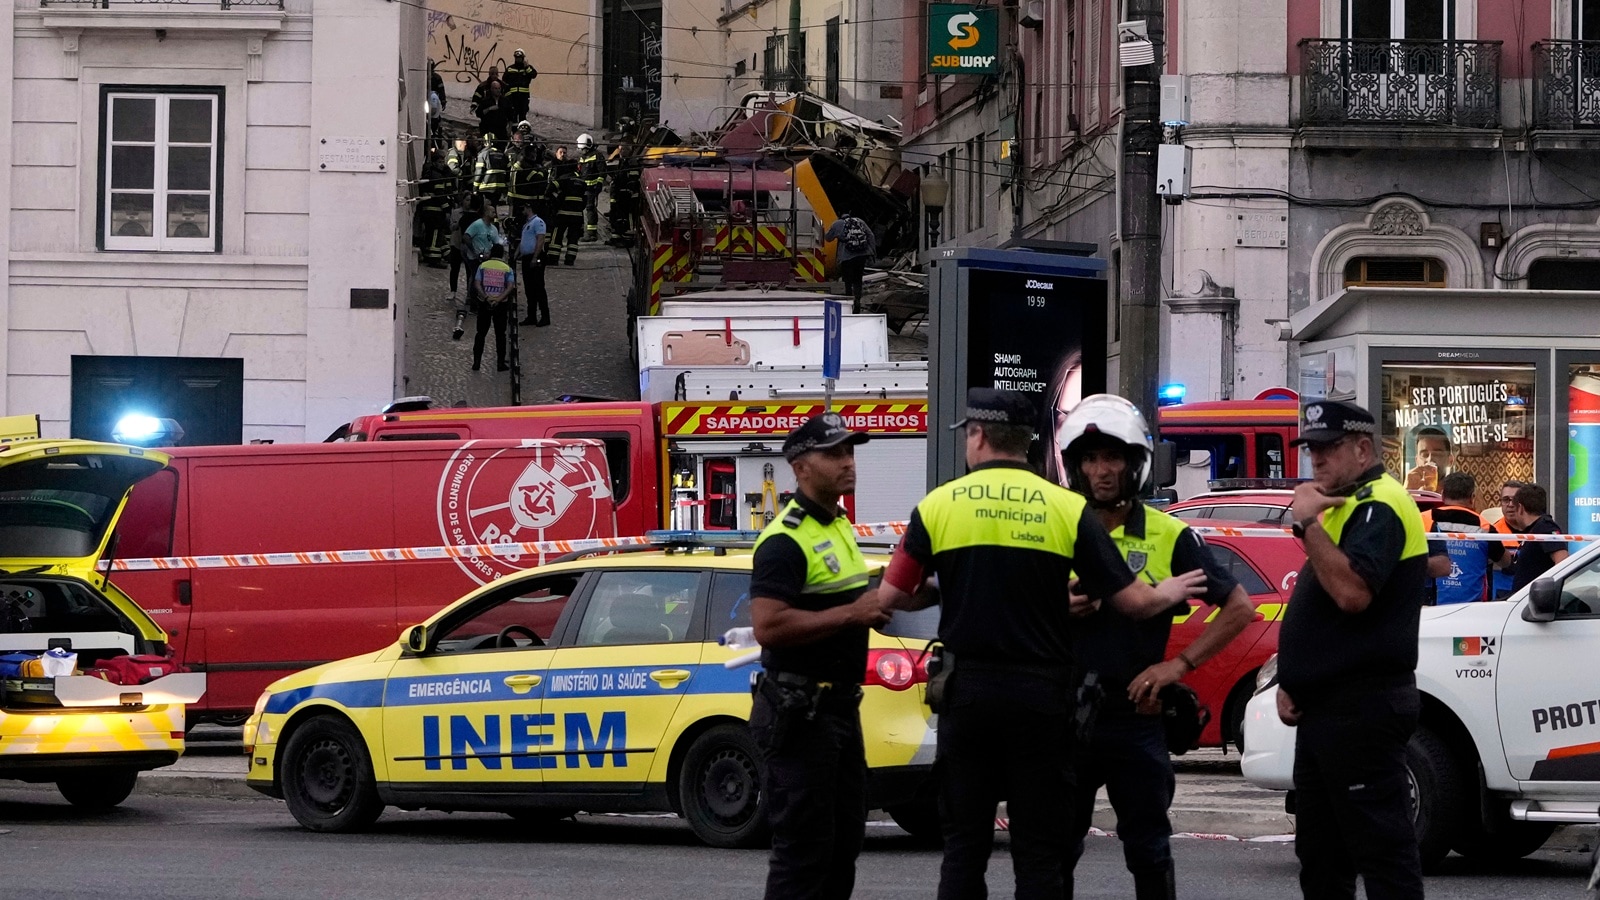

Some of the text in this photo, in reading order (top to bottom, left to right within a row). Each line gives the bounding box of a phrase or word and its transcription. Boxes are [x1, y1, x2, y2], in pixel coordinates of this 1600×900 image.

[931, 55, 996, 68] SUBWAY
[1025, 279, 1054, 290] JCDecaux
[828, 306, 838, 356] P
[994, 353, 1021, 364] SHAMIR
[993, 366, 1037, 378] AUTOGRAPH
[1412, 379, 1508, 406] SER PORTUGUÊS
[706, 416, 810, 429] SAPADORES
[841, 415, 919, 428] MBEIROS
[1395, 404, 1492, 428] NÃO SE EXPLICA,
[1453, 423, 1509, 445] SENTE-SE
[952, 483, 1047, 506] POLÍCIA
[448, 453, 494, 576] REGIMENTO DE SAPORES
[975, 507, 1047, 526] municipal
[1011, 530, 1045, 543] Lisboa
[408, 678, 492, 698] EMERGÊNCIA
[551, 669, 647, 692] MINISTÉRIO DA SAÚDE
[1531, 699, 1600, 733] PROT
[423, 711, 628, 771] INEM
